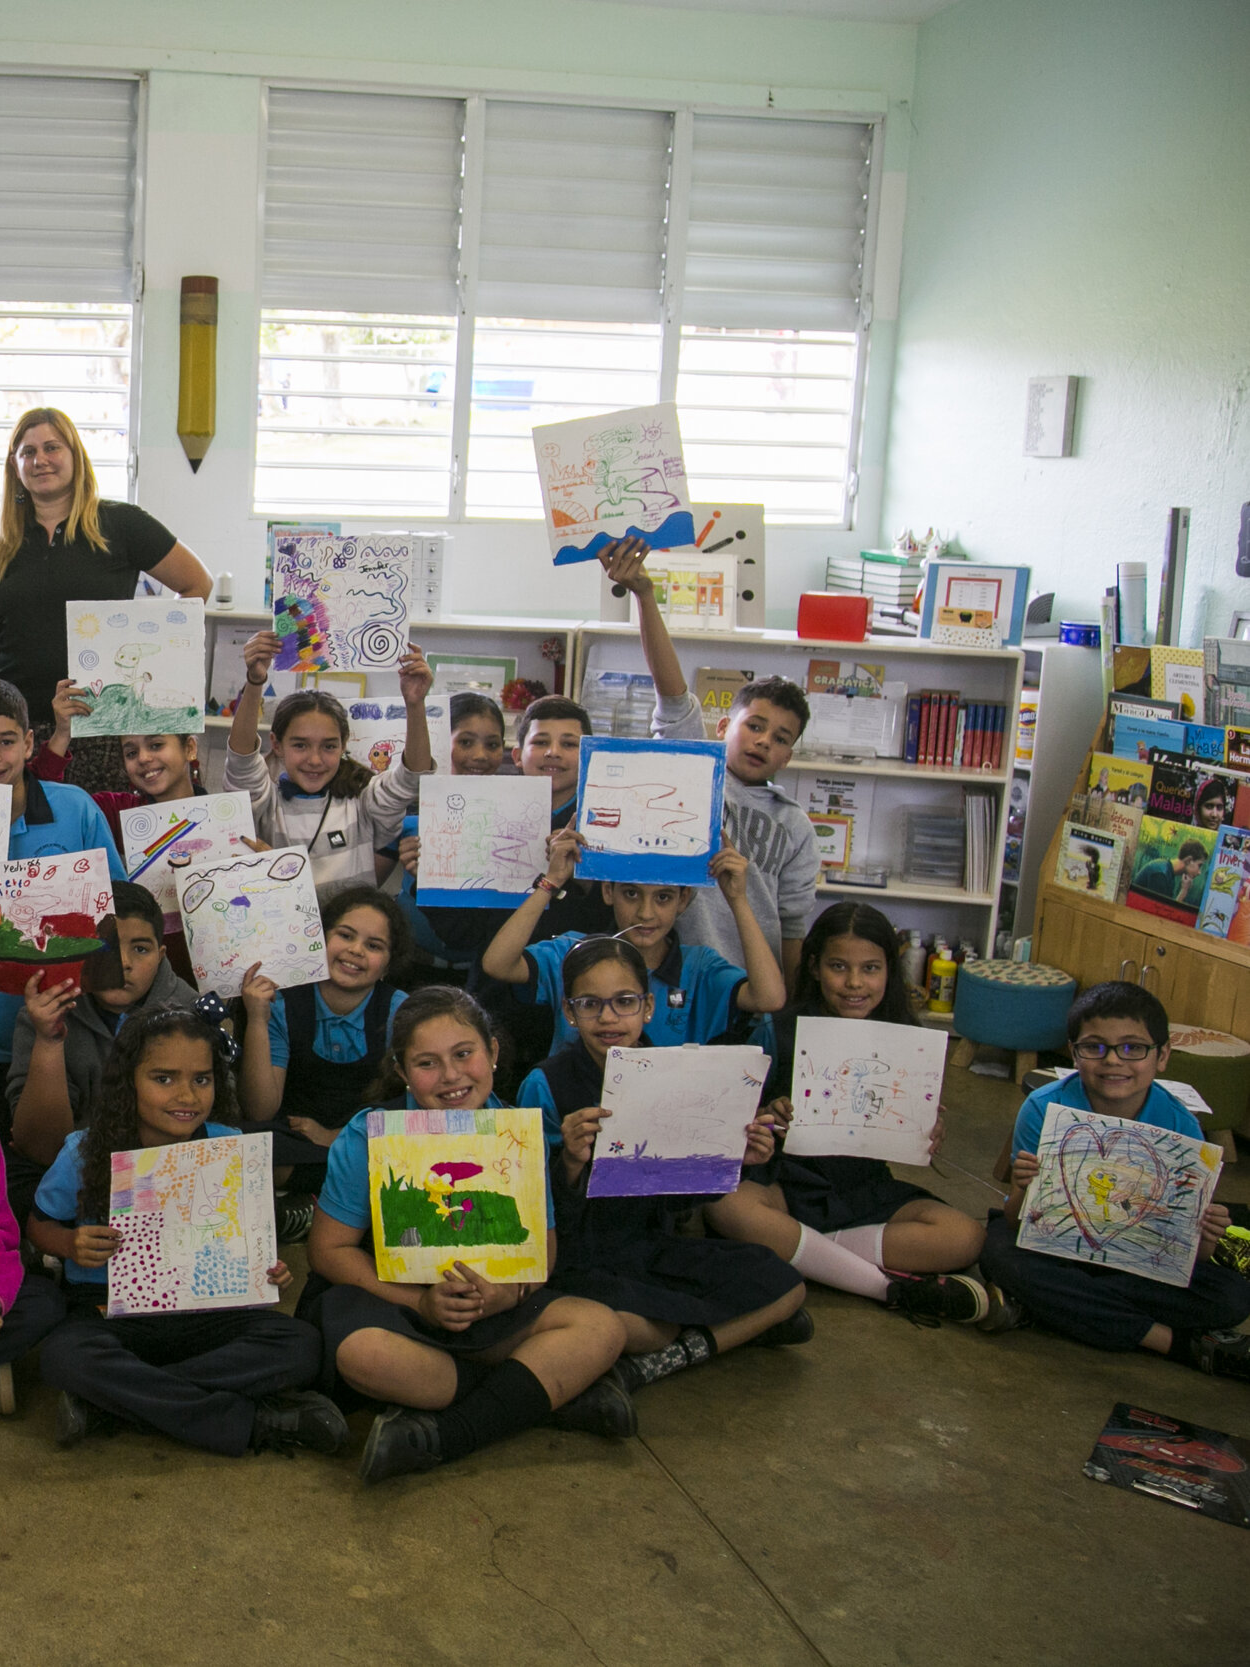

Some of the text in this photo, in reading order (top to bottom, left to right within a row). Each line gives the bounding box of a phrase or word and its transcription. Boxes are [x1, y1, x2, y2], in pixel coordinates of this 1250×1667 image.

[1187, 738, 1224, 757] drago
[1229, 751, 1250, 763] Horm
[1150, 793, 1193, 817] Malala
